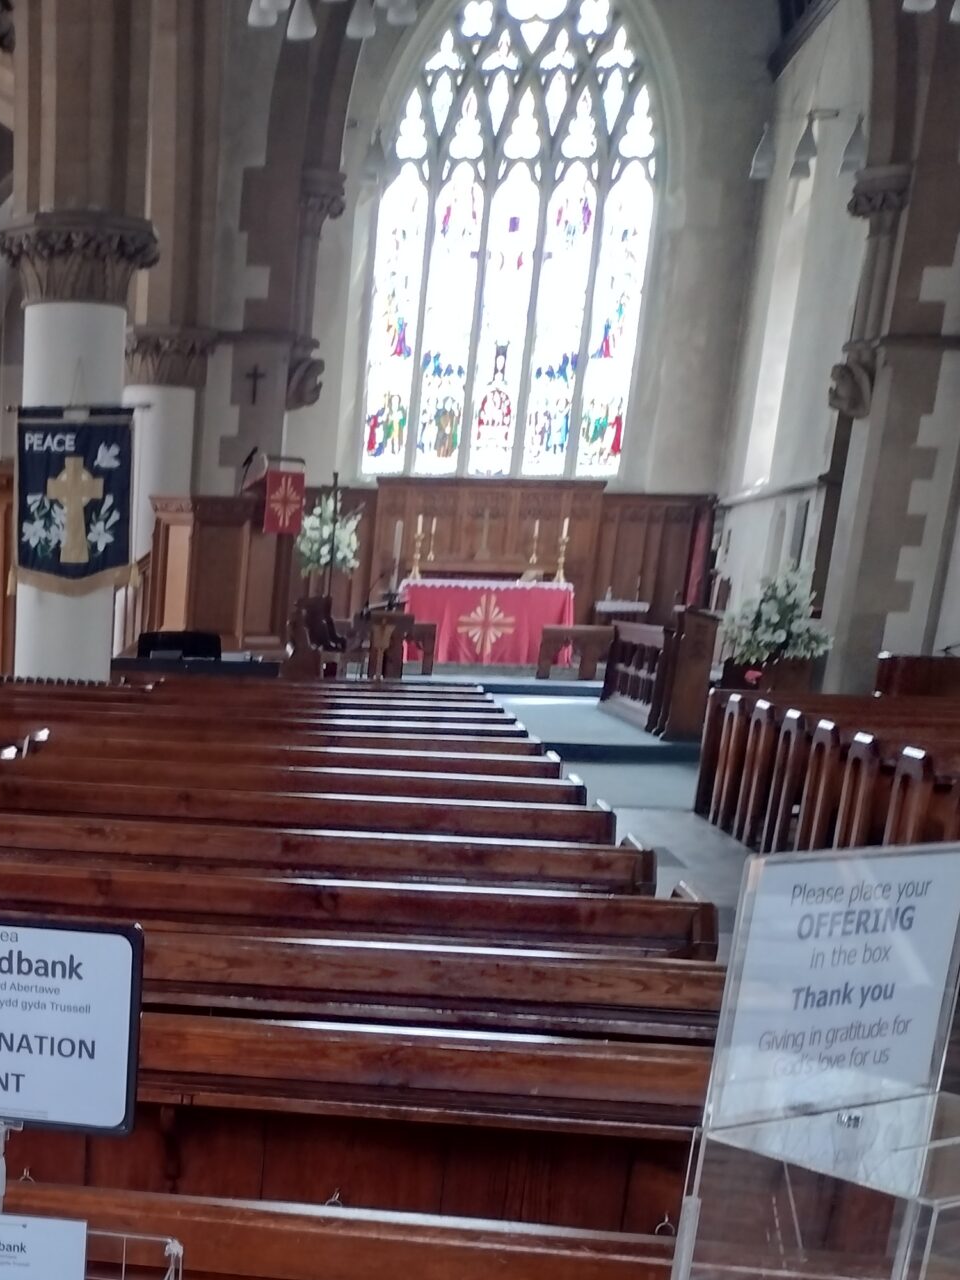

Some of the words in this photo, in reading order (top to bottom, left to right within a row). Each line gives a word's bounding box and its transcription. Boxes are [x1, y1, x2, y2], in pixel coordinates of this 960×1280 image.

[24, 432, 76, 452] PEACE
[792, 883, 844, 906] Please
[849, 880, 891, 909] place
[897, 879, 932, 903] your
[797, 905, 916, 940] OFFERING
[810, 948, 825, 970] in
[831, 946, 857, 967] the
[862, 943, 892, 964] box
[10, 982, 61, 995] Abertawe
[791, 982, 853, 1012] Thank
[859, 982, 896, 1009] you
[21, 1000, 47, 1011] gyda
[50, 1002, 91, 1014] Trussell
[759, 1030, 806, 1054] Giving
[809, 1026, 822, 1047] in
[825, 1017, 889, 1050] gratitude
[891, 1014, 913, 1036] for
[818, 1052, 846, 1072] love
[849, 1046, 870, 1068] for
[872, 1048, 890, 1064] us
